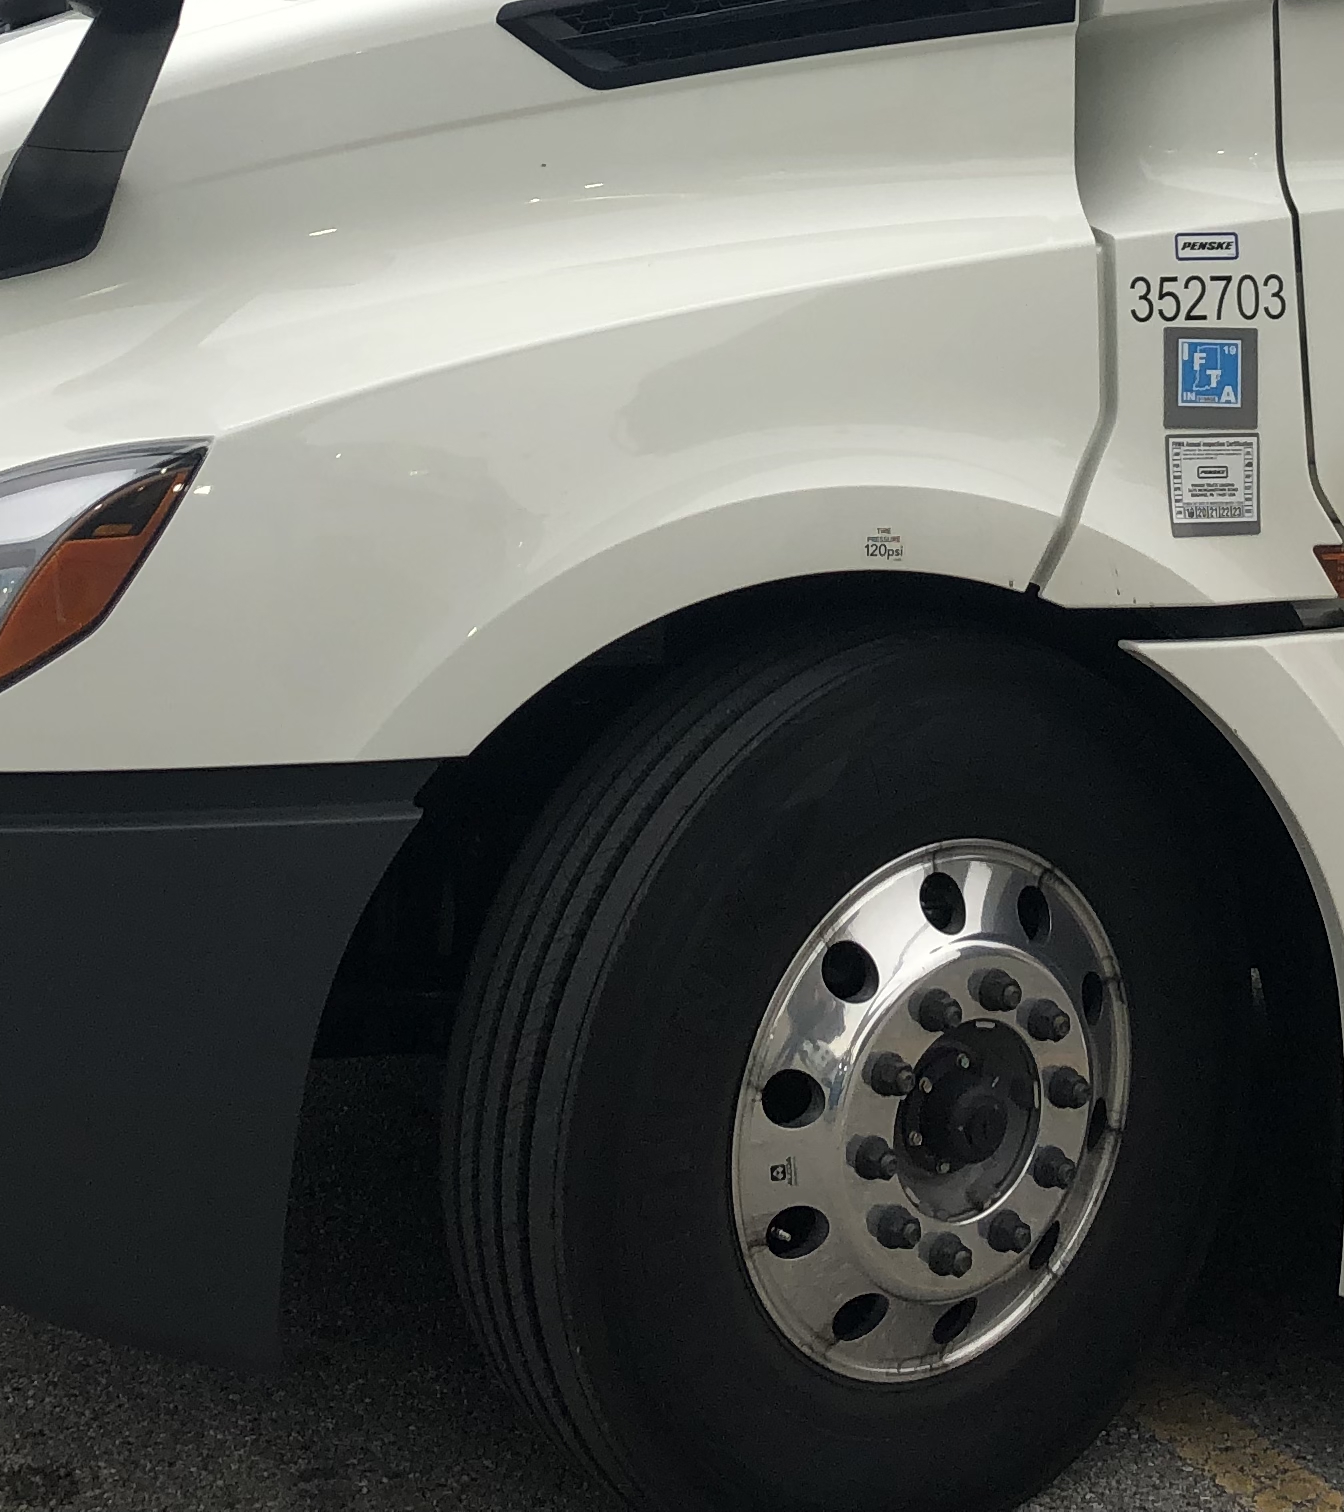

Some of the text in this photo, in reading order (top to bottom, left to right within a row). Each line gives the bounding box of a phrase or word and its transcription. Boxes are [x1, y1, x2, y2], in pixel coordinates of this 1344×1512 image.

[1181, 241, 1234, 251] PENSKE
[1129, 274, 1287, 323] 352703
[1182, 391, 1196, 401] IN
[864, 543, 903, 560] 120psi
